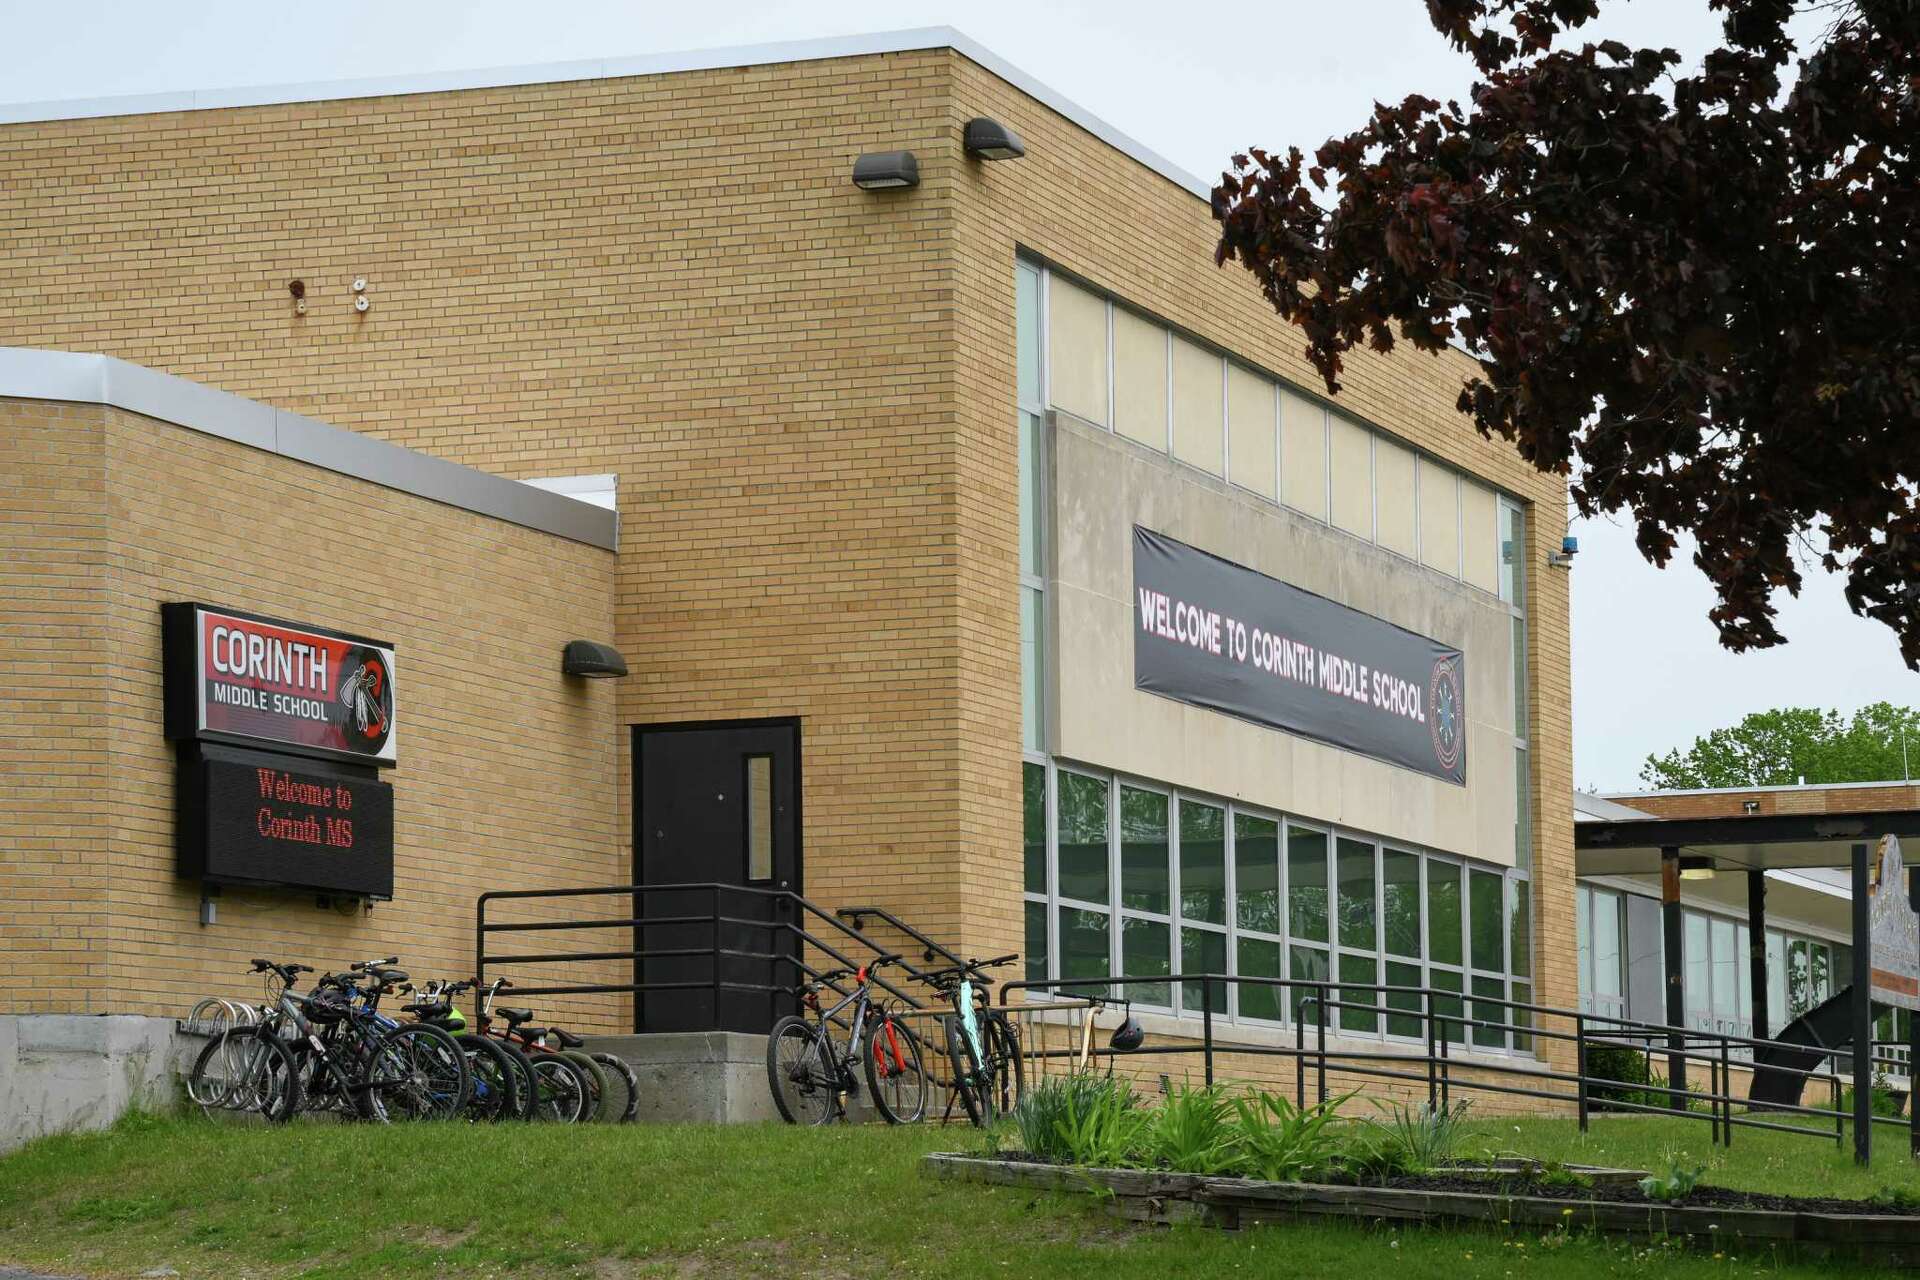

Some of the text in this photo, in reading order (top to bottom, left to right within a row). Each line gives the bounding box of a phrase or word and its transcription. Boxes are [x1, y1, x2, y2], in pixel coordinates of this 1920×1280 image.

[213, 626, 327, 691] CORINTH
[1139, 587, 1221, 655] WELCOME
[1226, 617, 1247, 662] TO
[1252, 628, 1314, 686] CORINTH
[1319, 650, 1368, 703] MIDDLE
[1372, 670, 1425, 721] SCHOOL
[214, 682, 328, 721] MIDDLE SCHOOL
[257, 768, 352, 810] Welcome to
[257, 808, 352, 848] Corinth MS
